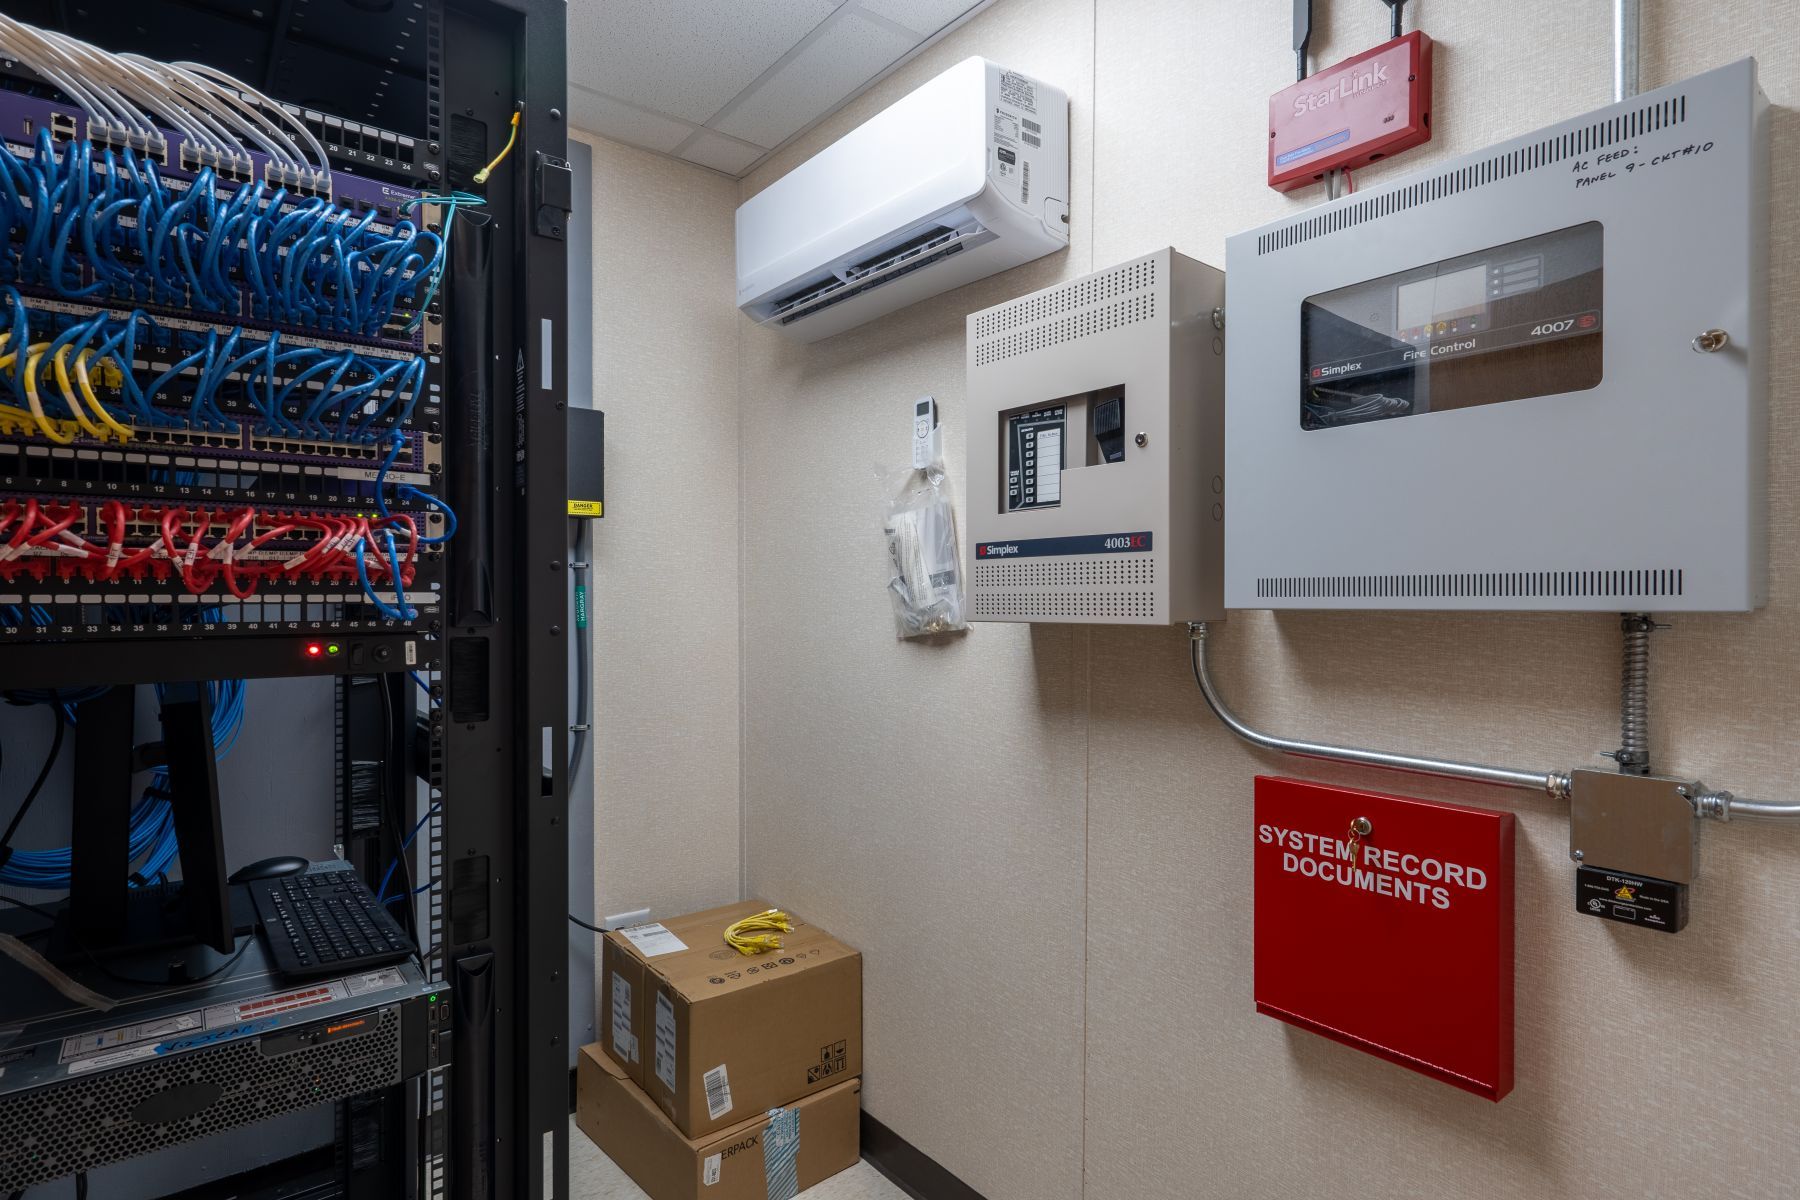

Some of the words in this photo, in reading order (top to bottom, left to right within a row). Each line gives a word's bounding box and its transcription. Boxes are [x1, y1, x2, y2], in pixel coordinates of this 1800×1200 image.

[1294, 61, 1389, 118] StarLink
[1572, 161, 1589, 173] AC
[1597, 146, 1639, 166] FEED:
[1576, 172, 1617, 189] PANEL
[1531, 320, 1575, 336] 4007
[182, 349, 191, 357] 13
[1403, 350, 1426, 361] Fire
[1430, 338, 1476, 356] Control
[1321, 362, 1362, 377] Simplex
[288, 406, 298, 414] 42
[364, 471, 406, 481] MERO-E
[202, 488, 212, 496] 14
[347, 496, 356, 504] 21
[986, 544, 1020, 557] Simplex
[1104, 535, 1147, 549] 4003EC
[6, 626, 18, 634] 30
[36, 626, 47, 634] 31
[110, 625, 122, 633] 34
[157, 624, 168, 632] 36
[386, 620, 395, 628] 47
[1258, 824, 1355, 863] SYSTEM
[1364, 845, 1487, 891] RECORD
[1283, 852, 1451, 910] DOCUMENTS
